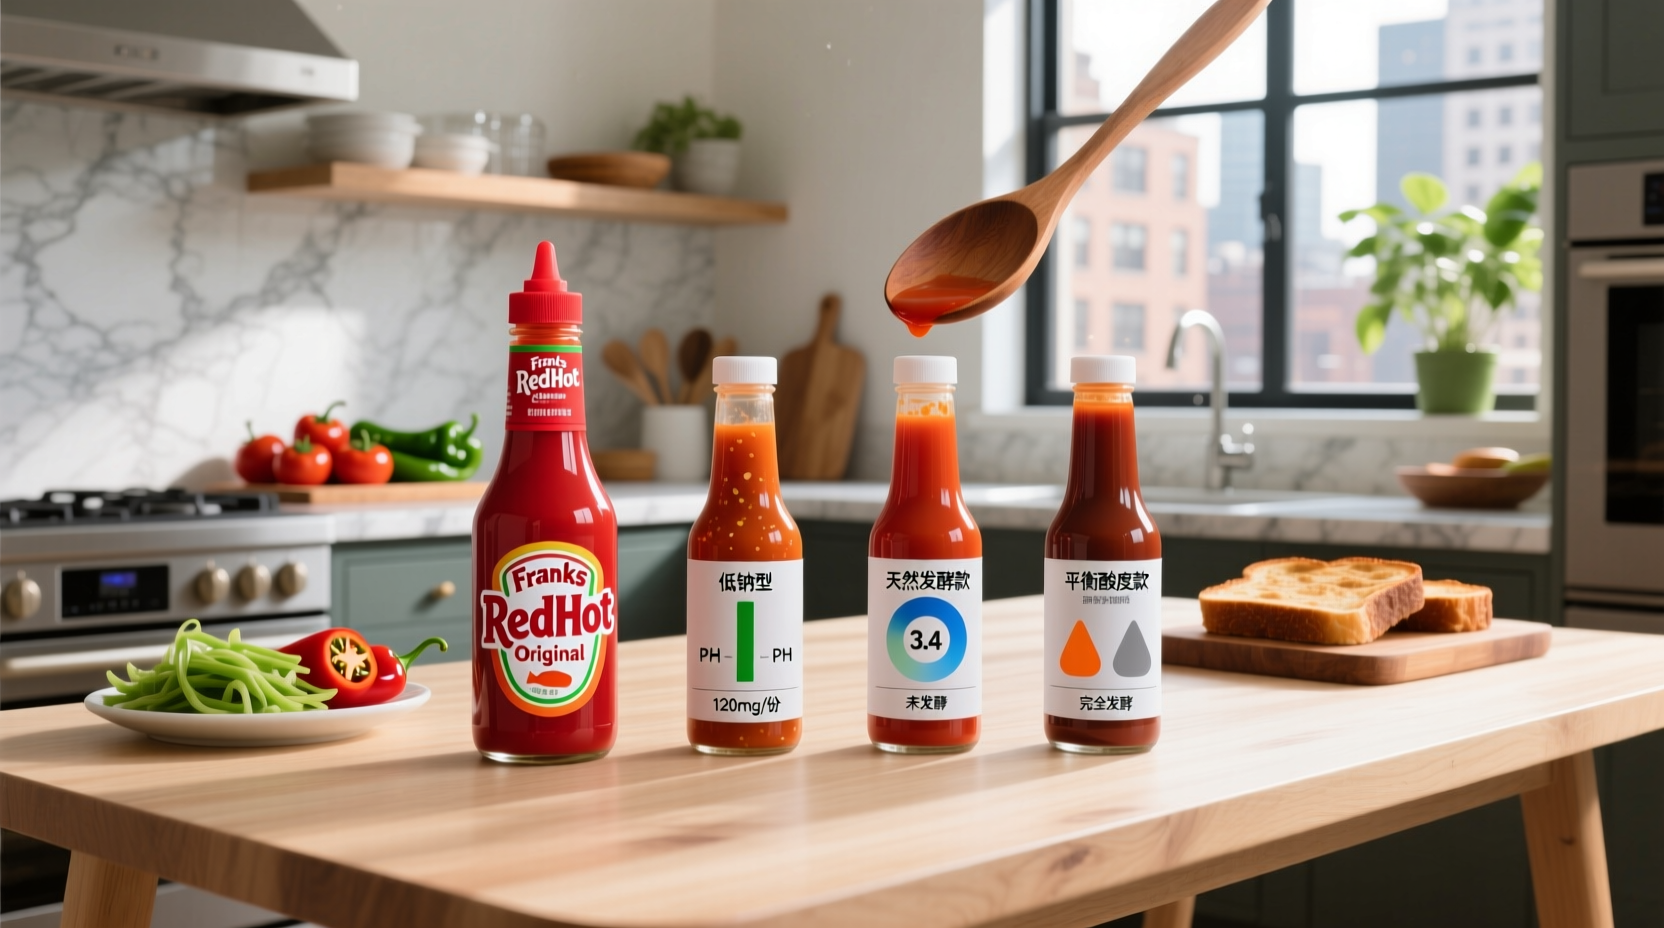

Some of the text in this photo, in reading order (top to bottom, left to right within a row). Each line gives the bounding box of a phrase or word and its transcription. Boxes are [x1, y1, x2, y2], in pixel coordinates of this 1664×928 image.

[516, 367, 580, 396] RedHot
[511, 561, 588, 593] Franks
[718, 571, 773, 593] 低钠型
[886, 570, 971, 591] 天然发酵款
[1065, 570, 1150, 592] 平衡酸度款
[483, 592, 613, 649] RedHot
[910, 629, 942, 650] 3.4
[514, 643, 585, 667] Original
[699, 647, 721, 663] PH
[772, 647, 793, 663] PH
